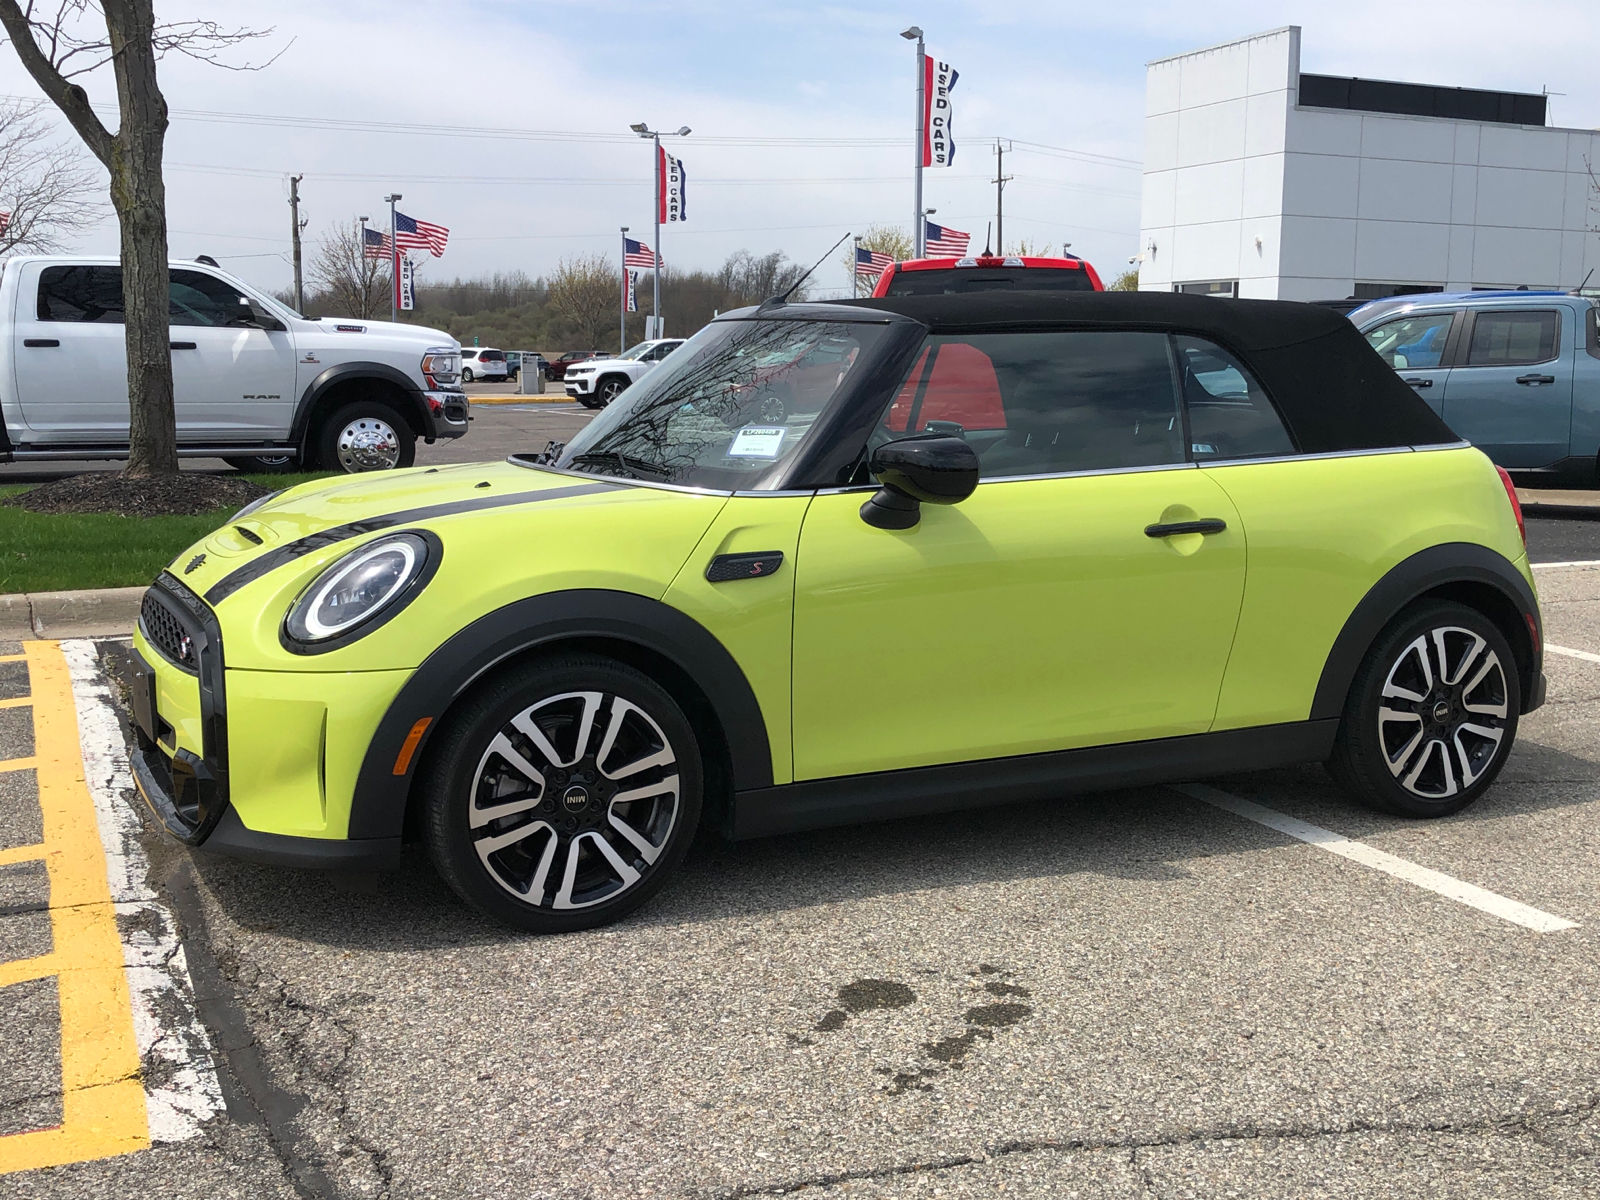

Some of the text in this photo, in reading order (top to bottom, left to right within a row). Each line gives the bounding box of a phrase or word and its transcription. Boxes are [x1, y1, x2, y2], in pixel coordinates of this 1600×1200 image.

[932, 61, 949, 164] USED CARS
[670, 188, 678, 222] CARS
[402, 283, 410, 308] CARS
[749, 562, 763, 574] S
[566, 795, 586, 804] MINI
